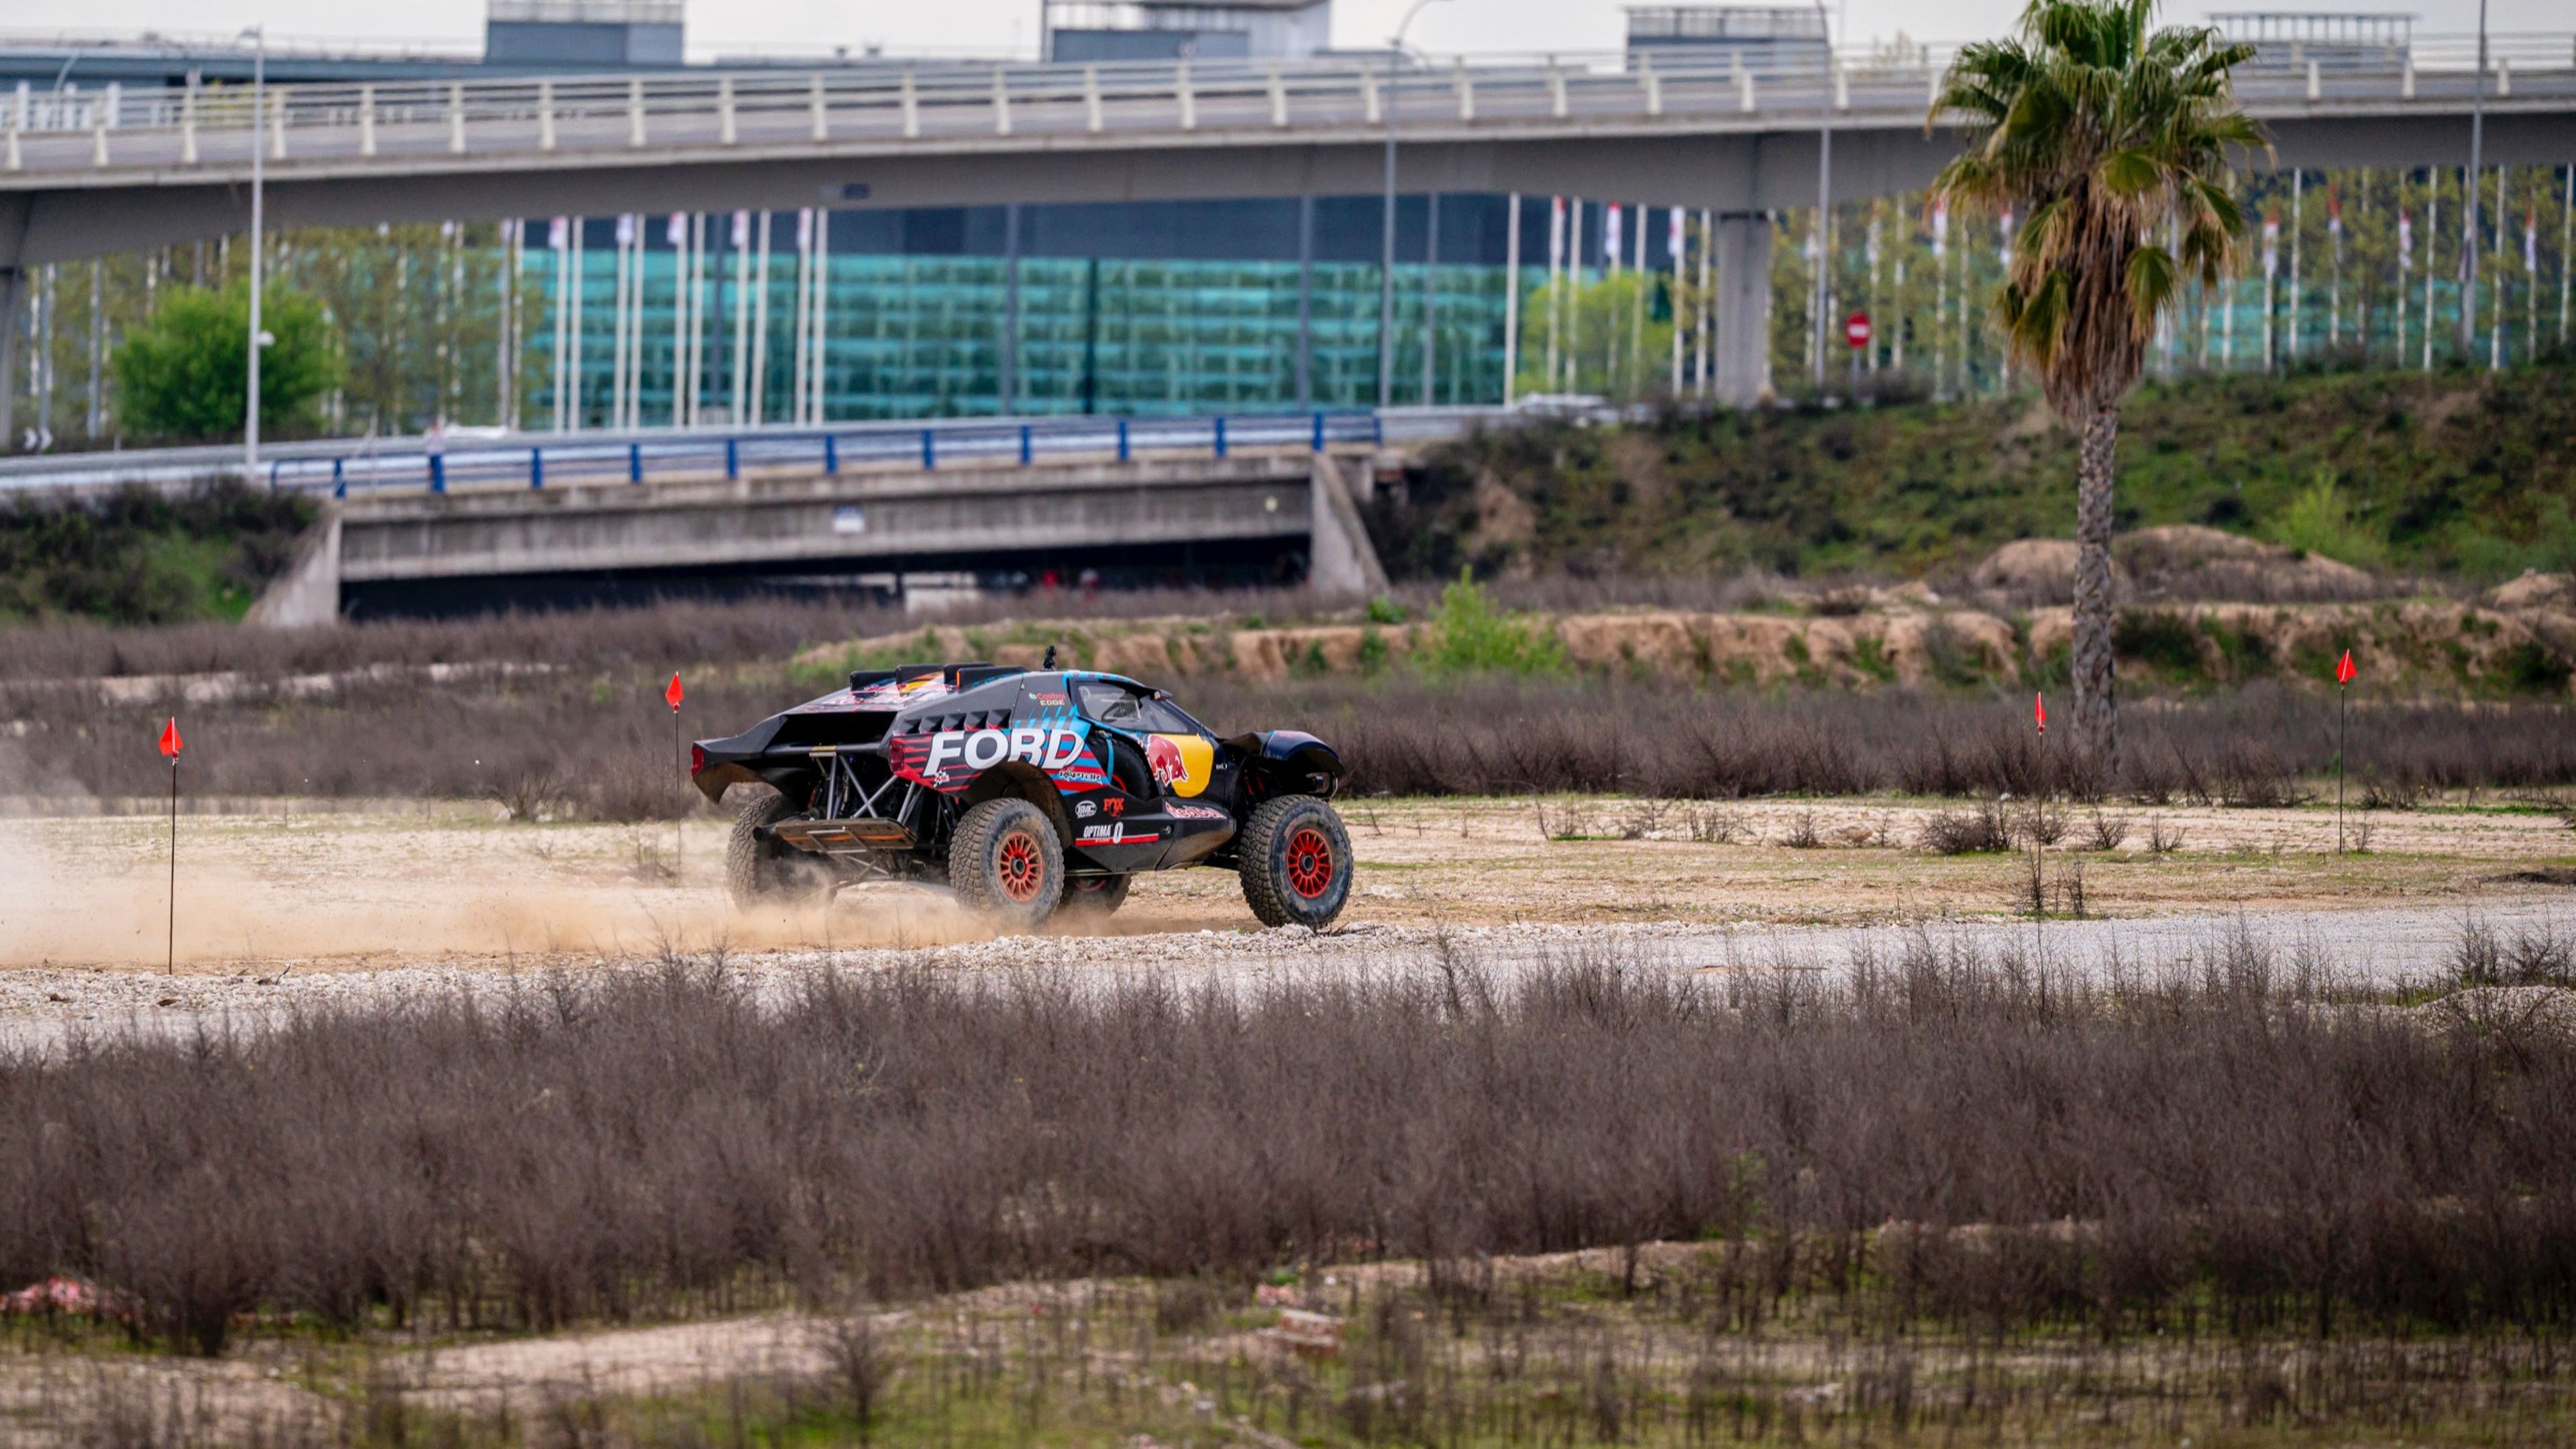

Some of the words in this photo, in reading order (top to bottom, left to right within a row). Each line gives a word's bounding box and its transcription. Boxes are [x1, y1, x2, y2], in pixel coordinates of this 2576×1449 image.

[923, 729, 1085, 777] FORD
[1104, 798, 1124, 817] FOX
[1083, 825, 1112, 838] OPTIMA
